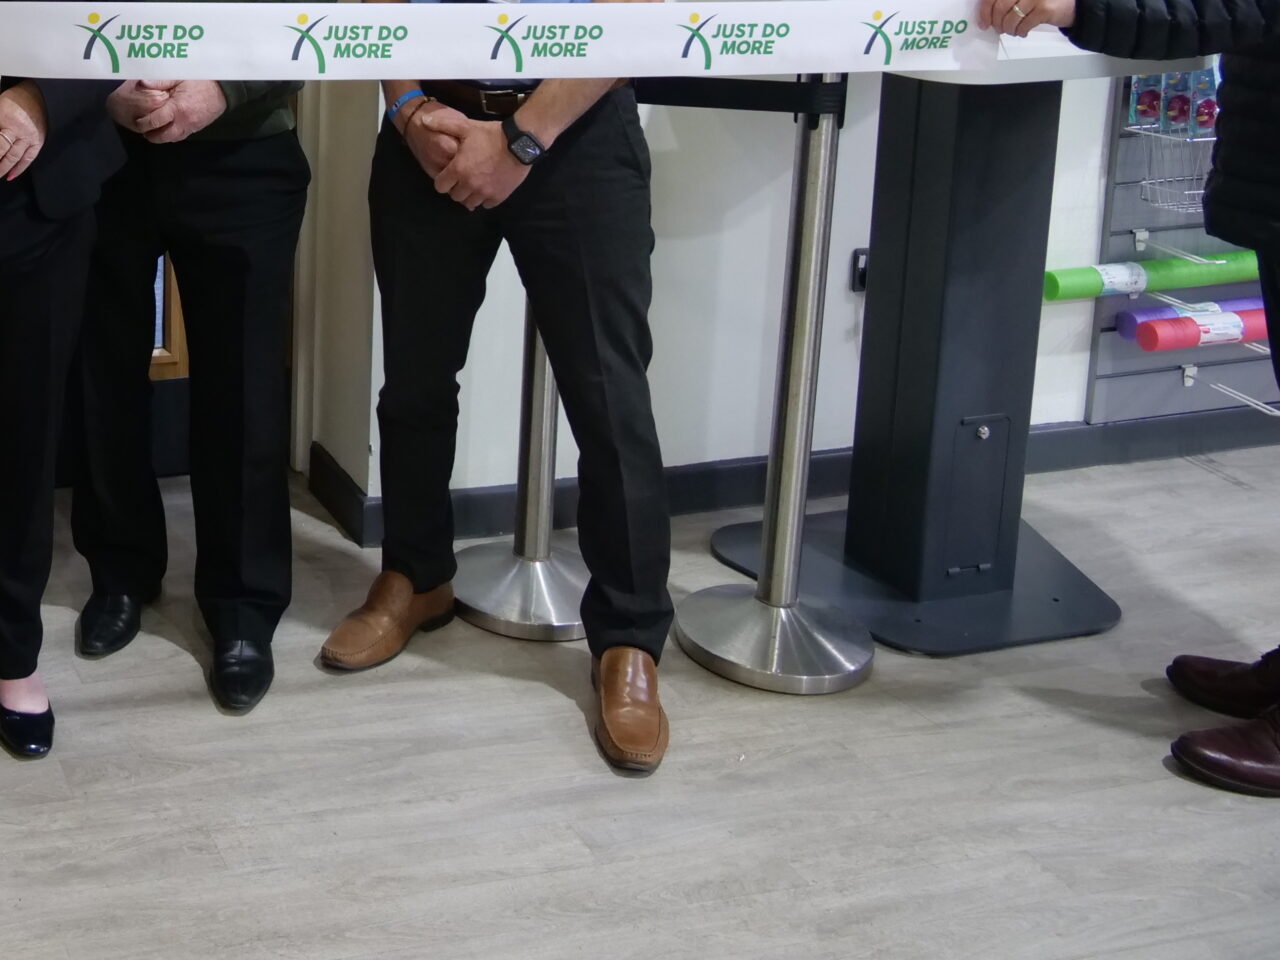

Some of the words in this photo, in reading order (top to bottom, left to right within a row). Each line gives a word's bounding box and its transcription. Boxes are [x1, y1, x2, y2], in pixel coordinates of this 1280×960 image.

[115, 24, 169, 41] JUST
[170, 24, 205, 41] DO
[323, 25, 374, 42] JUST
[375, 24, 408, 41] DO
[521, 24, 571, 40] JUST
[573, 24, 604, 40] DO
[711, 23, 760, 39] JUST
[761, 22, 790, 38] DO
[894, 21, 940, 36] JUST
[941, 19, 968, 35] DO
[127, 41, 189, 59] MORE
[332, 41, 393, 59] MORE
[530, 40, 588, 58] MORE
[720, 39, 775, 55] MORE
[899, 35, 949, 51] MORE
